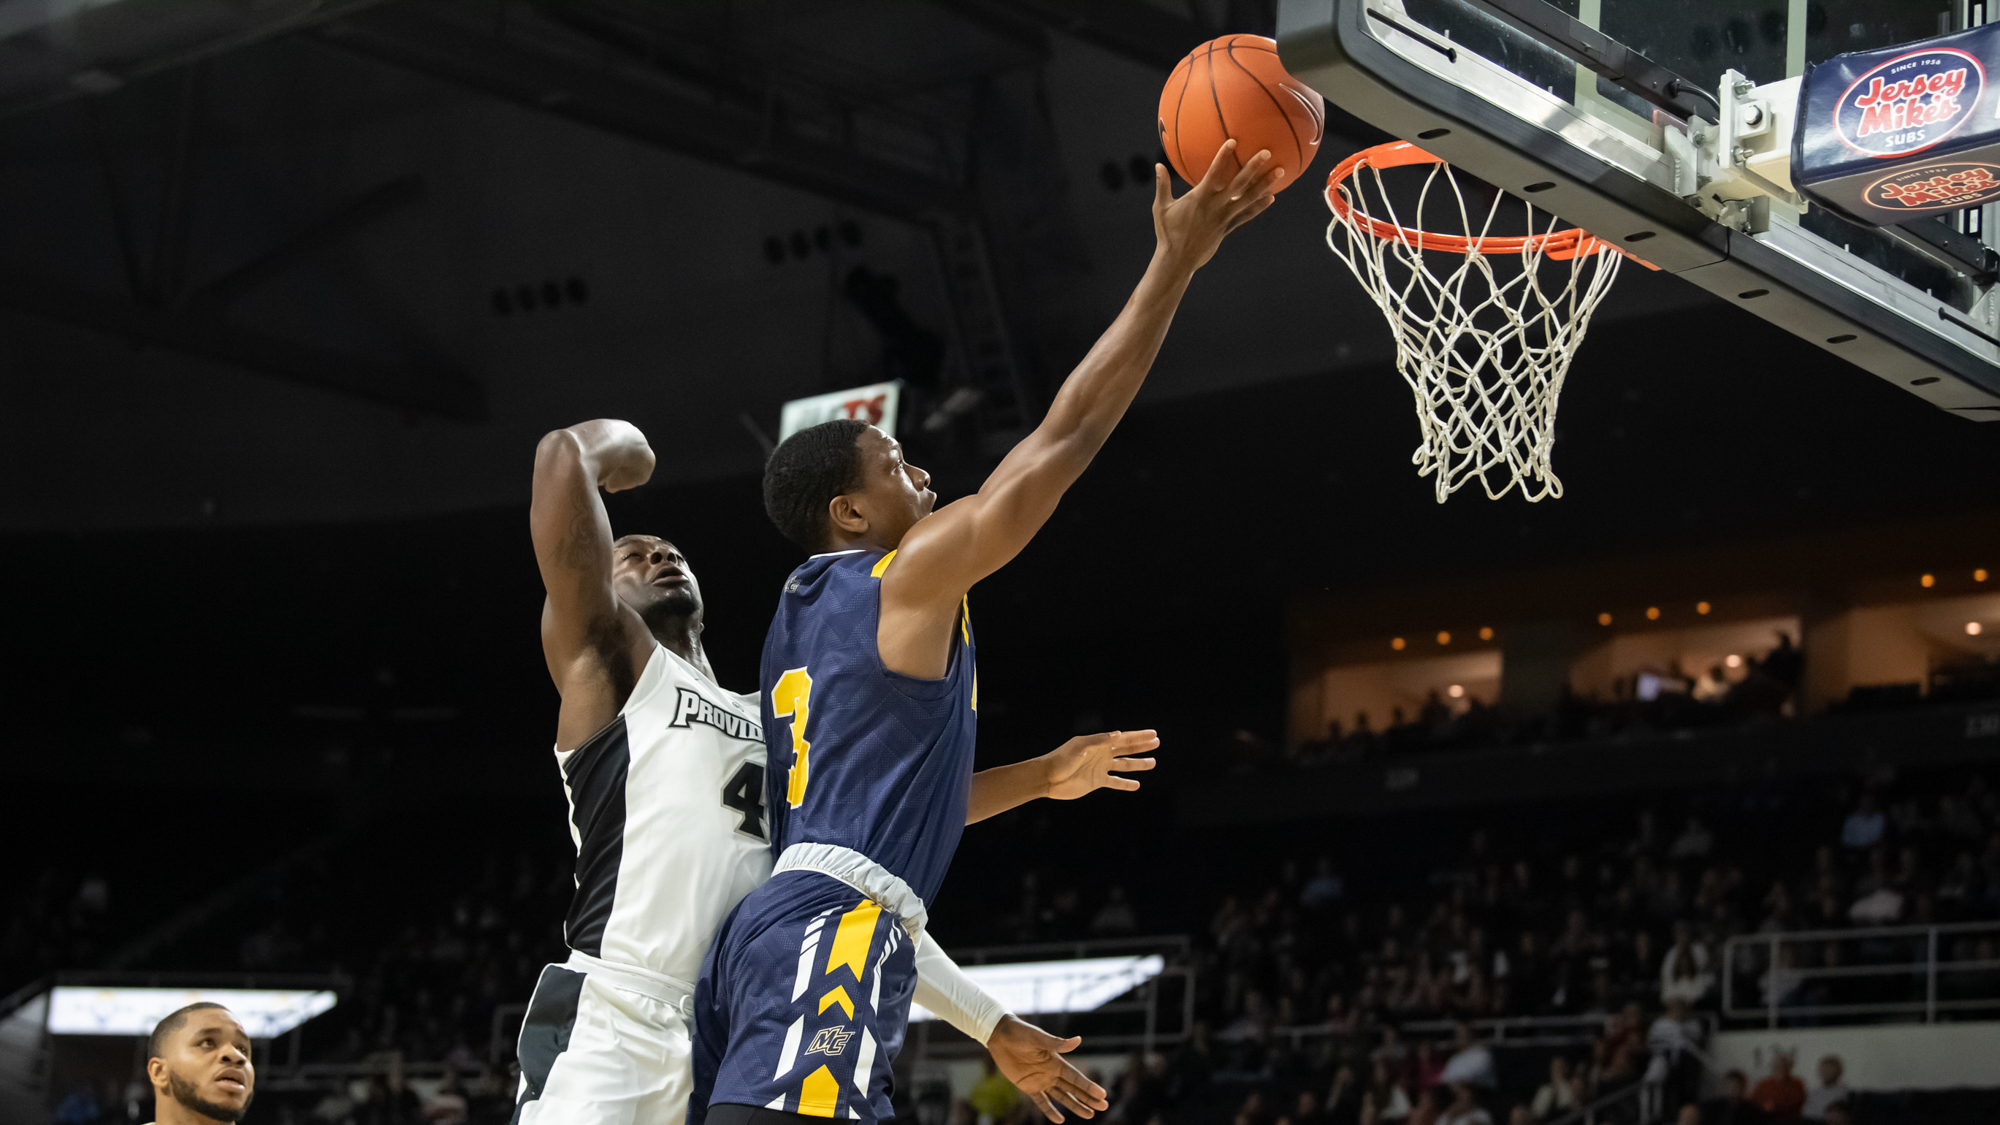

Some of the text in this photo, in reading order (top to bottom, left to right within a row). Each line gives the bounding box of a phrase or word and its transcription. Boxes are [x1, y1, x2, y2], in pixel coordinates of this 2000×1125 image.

[1891, 61, 1917, 75] SINCE
[1855, 68, 1967, 107] Jersey
[1857, 95, 1962, 138] Mike's
[1885, 130, 1926, 148] SUBS
[1881, 168, 1993, 199] Jersey
[1896, 172, 1921, 182] SINCE
[1898, 180, 2000, 207] Mike's
[1941, 193, 1983, 205] SUBS
[667, 686, 766, 744] PROVID
[771, 666, 813, 810] 3
[720, 759, 770, 844] 4
[804, 1025, 856, 1056] MC
